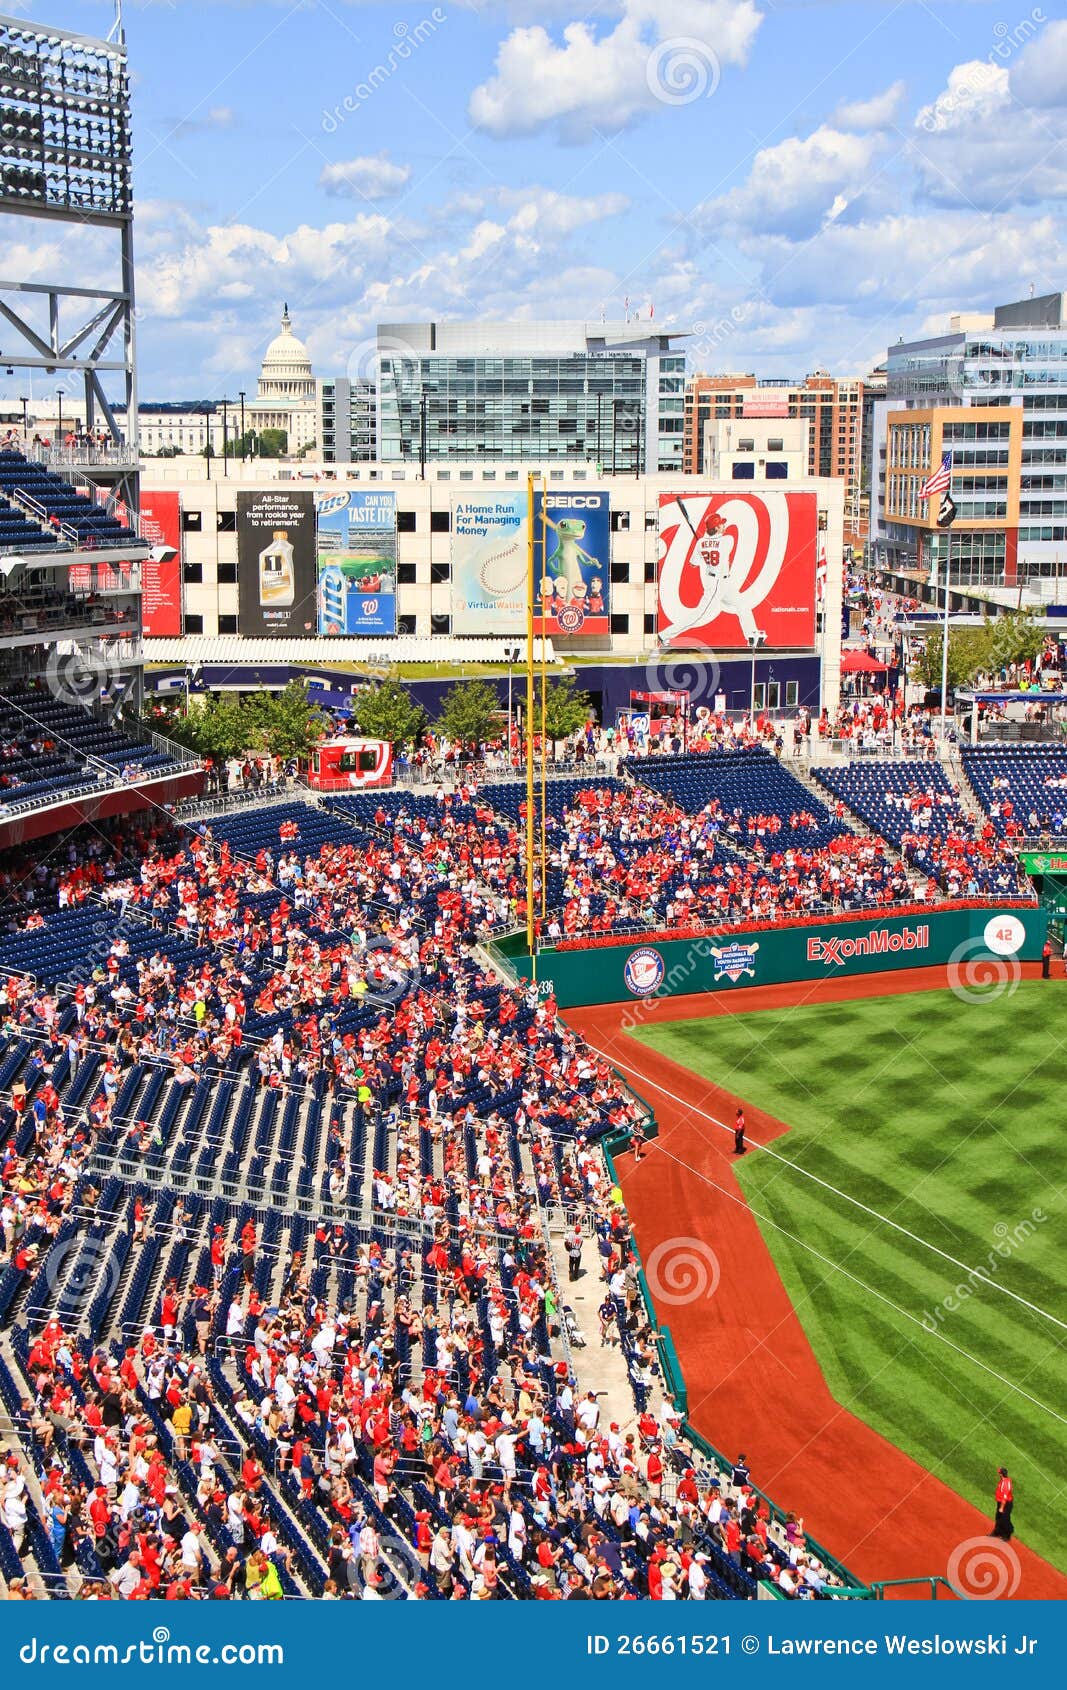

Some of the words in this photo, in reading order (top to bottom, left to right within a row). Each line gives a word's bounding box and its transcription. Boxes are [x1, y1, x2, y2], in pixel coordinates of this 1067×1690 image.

[262, 495, 289, 503] All-Star
[365, 495, 379, 506] CAN
[379, 495, 393, 506] YOU
[541, 496, 601, 508] GEICO
[252, 503, 299, 512] performance
[456, 504, 463, 514] A
[465, 504, 493, 514] Home
[495, 504, 514, 514] Run
[246, 511, 263, 519] from
[265, 511, 288, 519] rookie
[289, 512, 305, 520] year
[347, 507, 376, 523] TASTE
[377, 507, 393, 523] IT?
[251, 519, 259, 527] to
[260, 519, 300, 527] retirement.
[456, 515, 472, 525] For
[474, 515, 521, 527] Managing
[456, 526, 488, 537] Money
[701, 540, 720, 549] WERTH
[995, 928, 1013, 941] 42
[806, 924, 929, 966] ExxonMobil
[539, 979, 554, 995] 336
